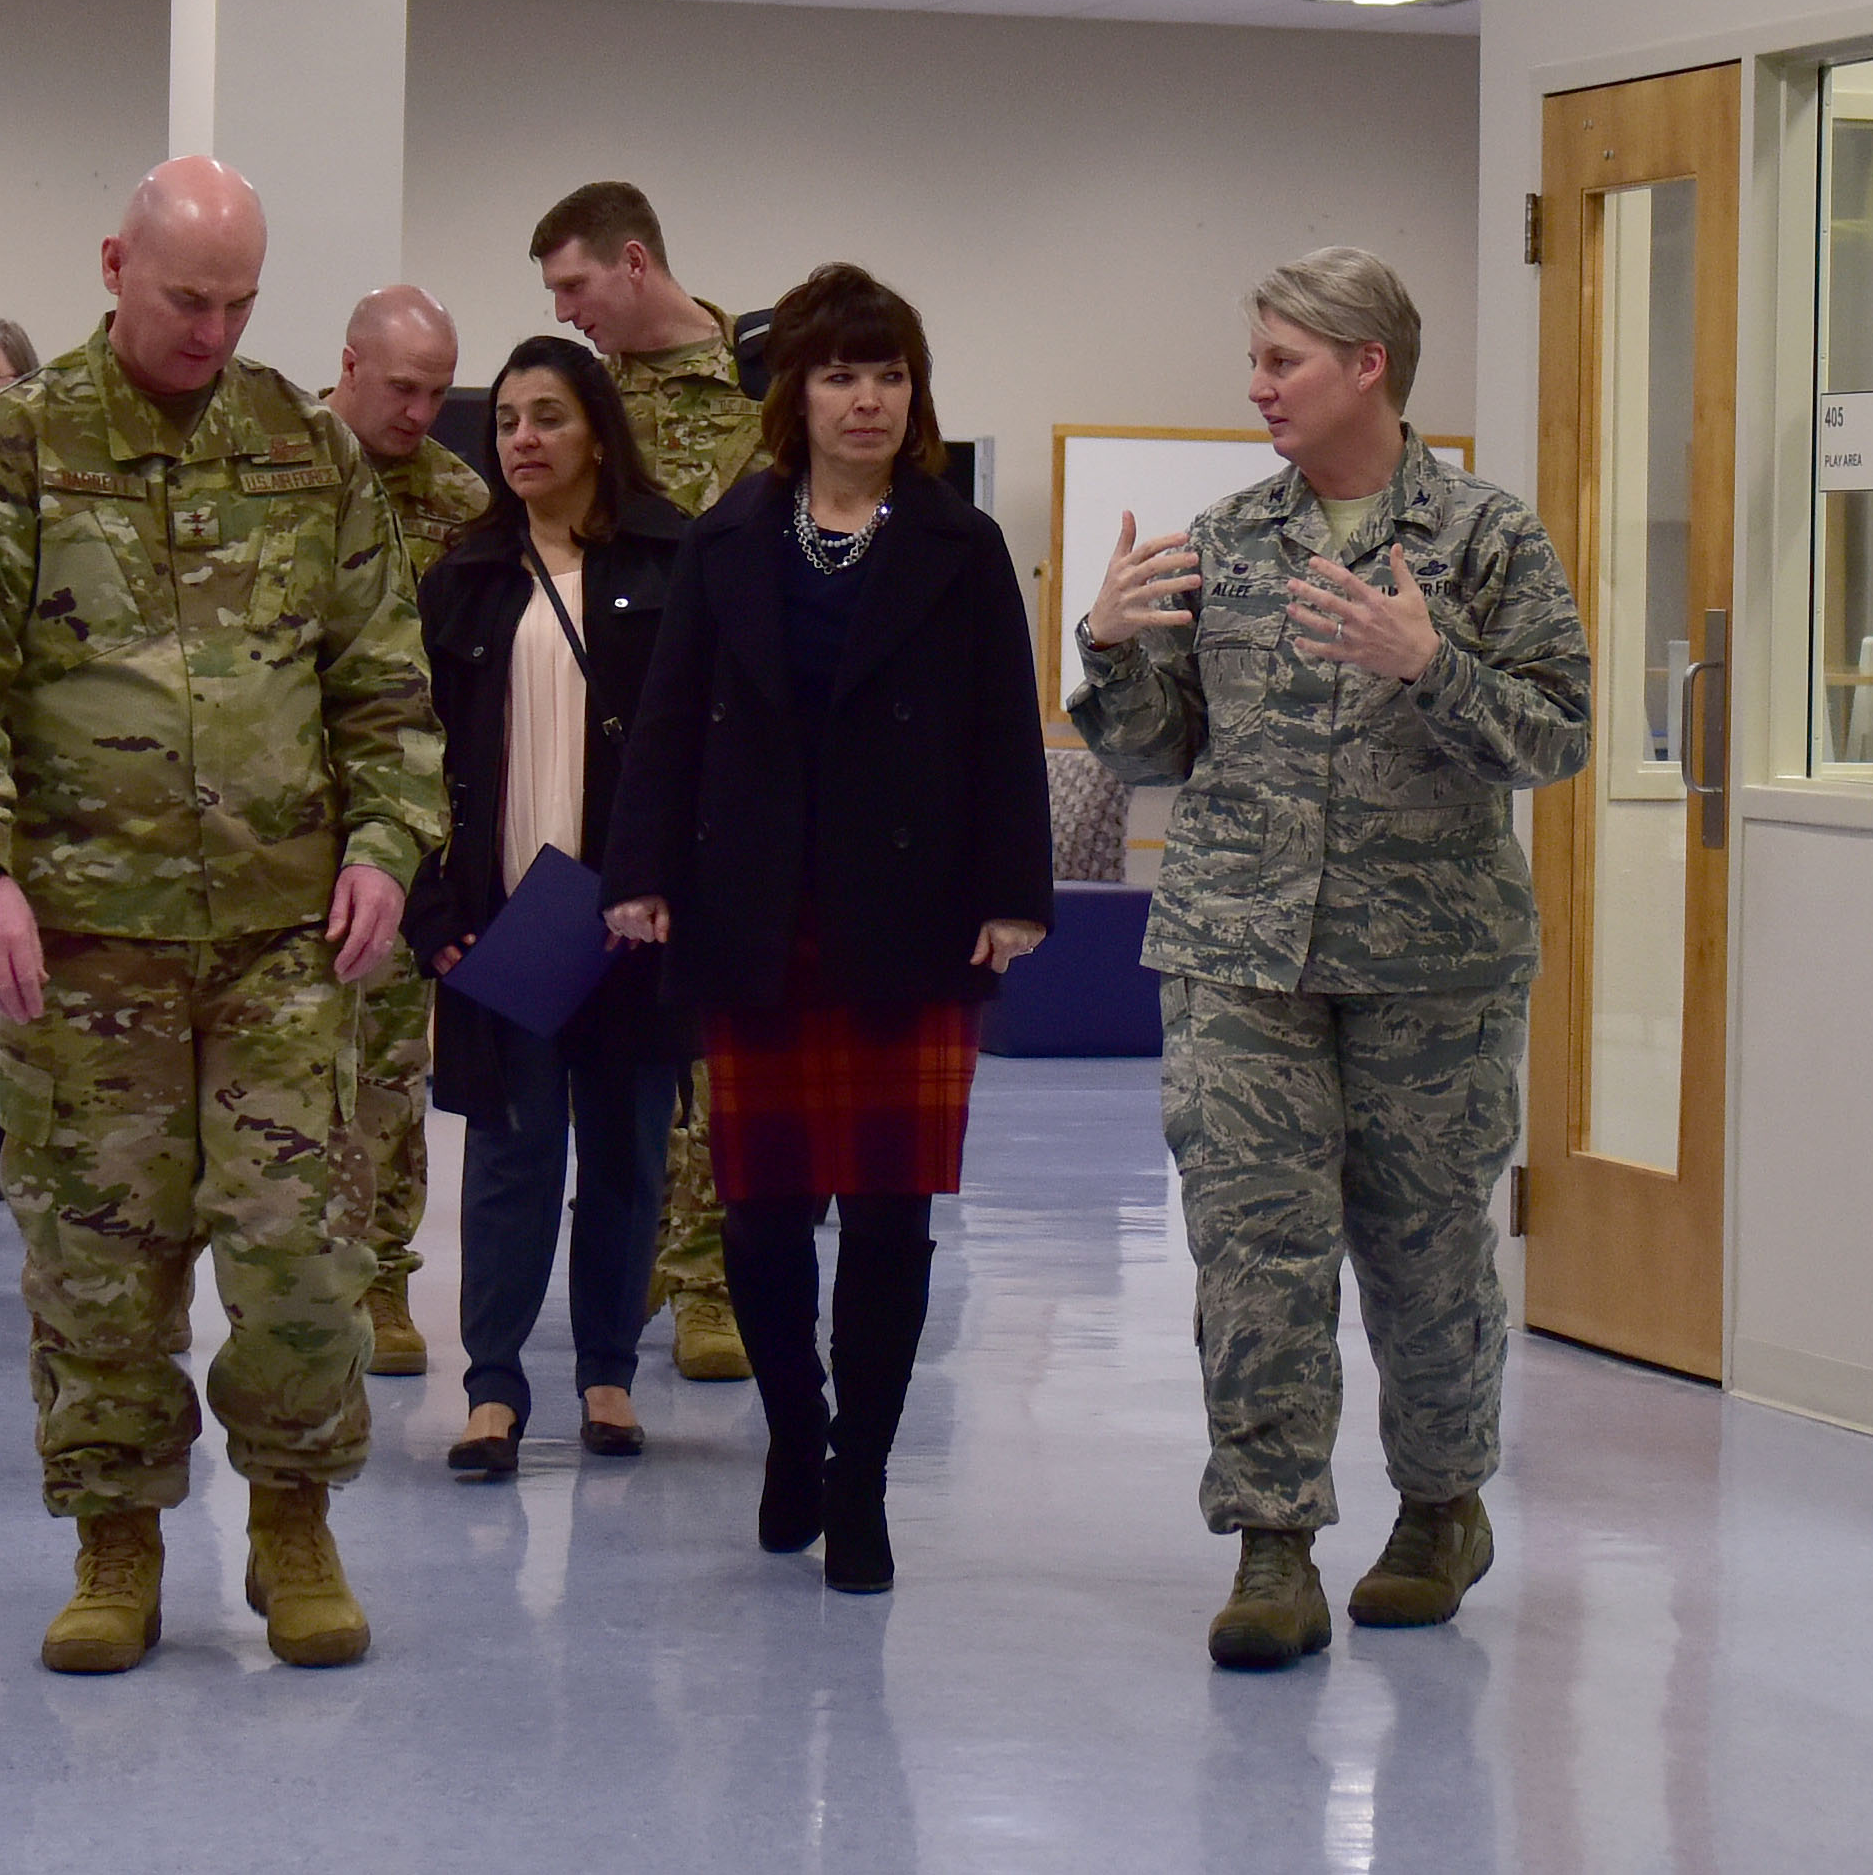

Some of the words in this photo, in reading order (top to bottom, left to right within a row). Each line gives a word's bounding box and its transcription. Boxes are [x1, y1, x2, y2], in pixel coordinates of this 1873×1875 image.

[1825, 406, 1844, 428] 405
[1824, 454, 1843, 468] PLAY
[1843, 452, 1862, 467] AREA
